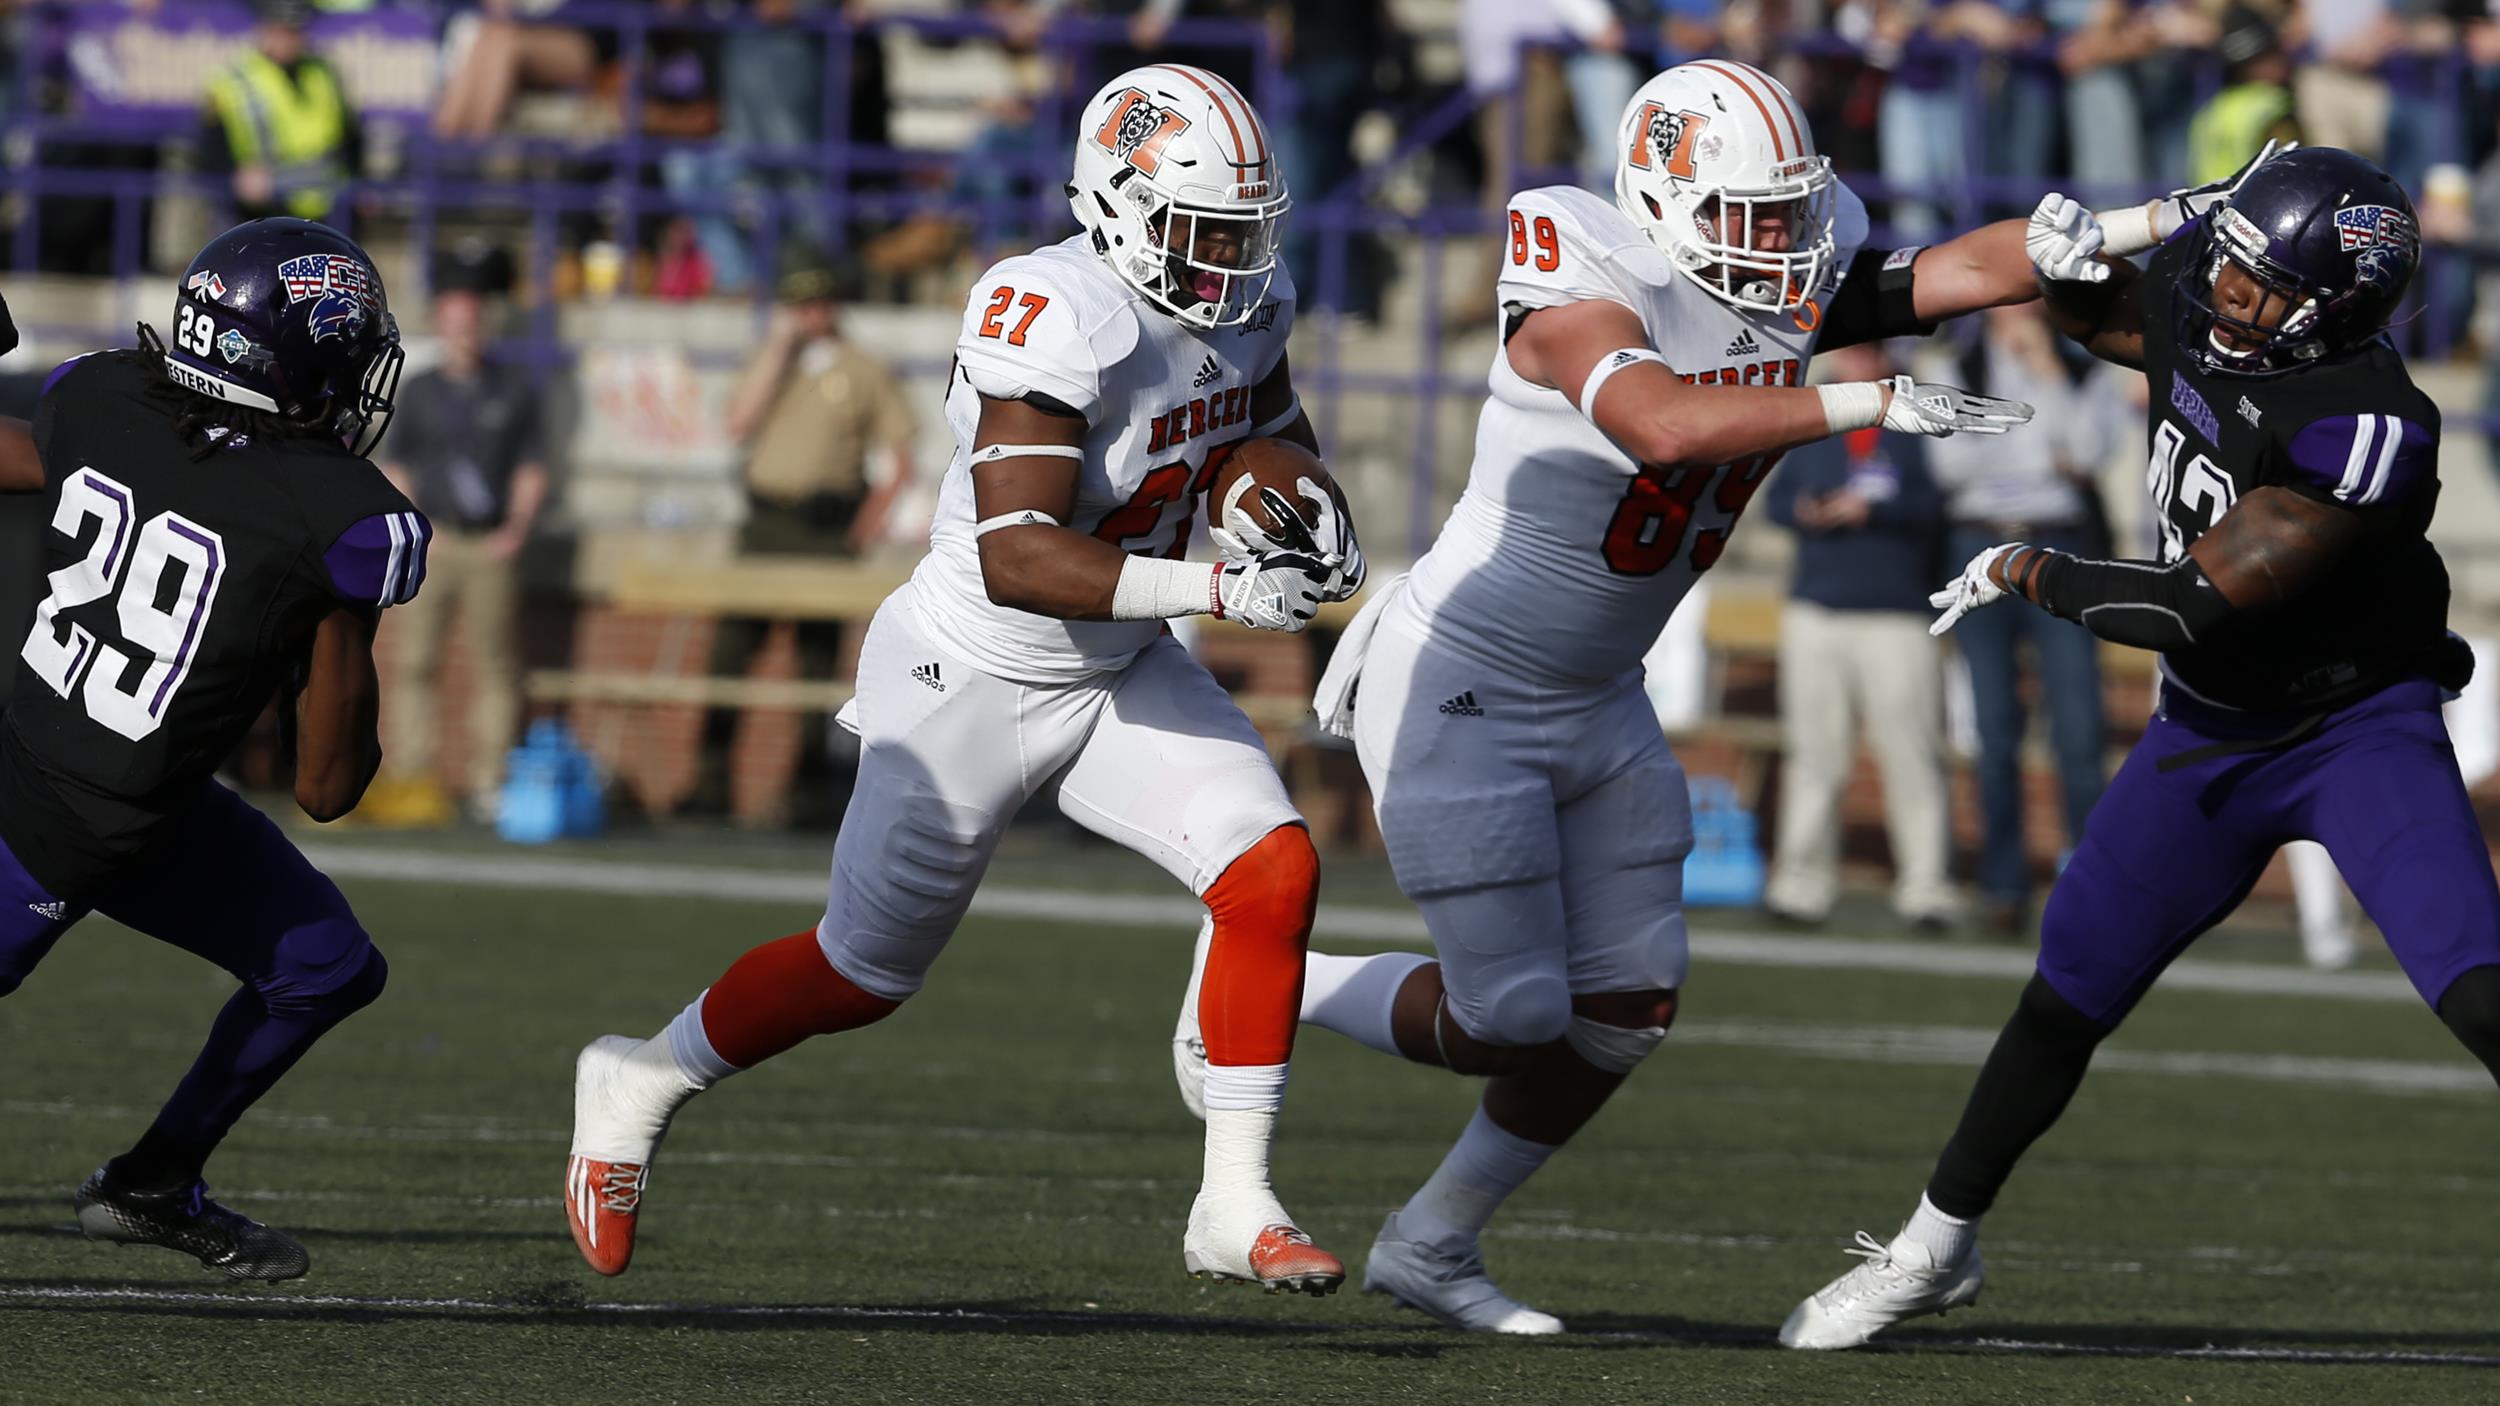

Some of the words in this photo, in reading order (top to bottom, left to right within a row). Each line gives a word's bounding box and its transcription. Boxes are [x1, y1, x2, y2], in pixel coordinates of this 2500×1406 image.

[1509, 210, 1560, 272] 89
[978, 286, 1049, 347] 27
[178, 304, 215, 357] 29
[1725, 344, 1760, 357] adidas
[1193, 368, 1223, 388] adidas
[1676, 359, 1799, 387] RCER
[21, 466, 227, 742] 29
[911, 668, 946, 693] adidas
[1438, 704, 1484, 717] adidas
[28, 903, 66, 921] adida
